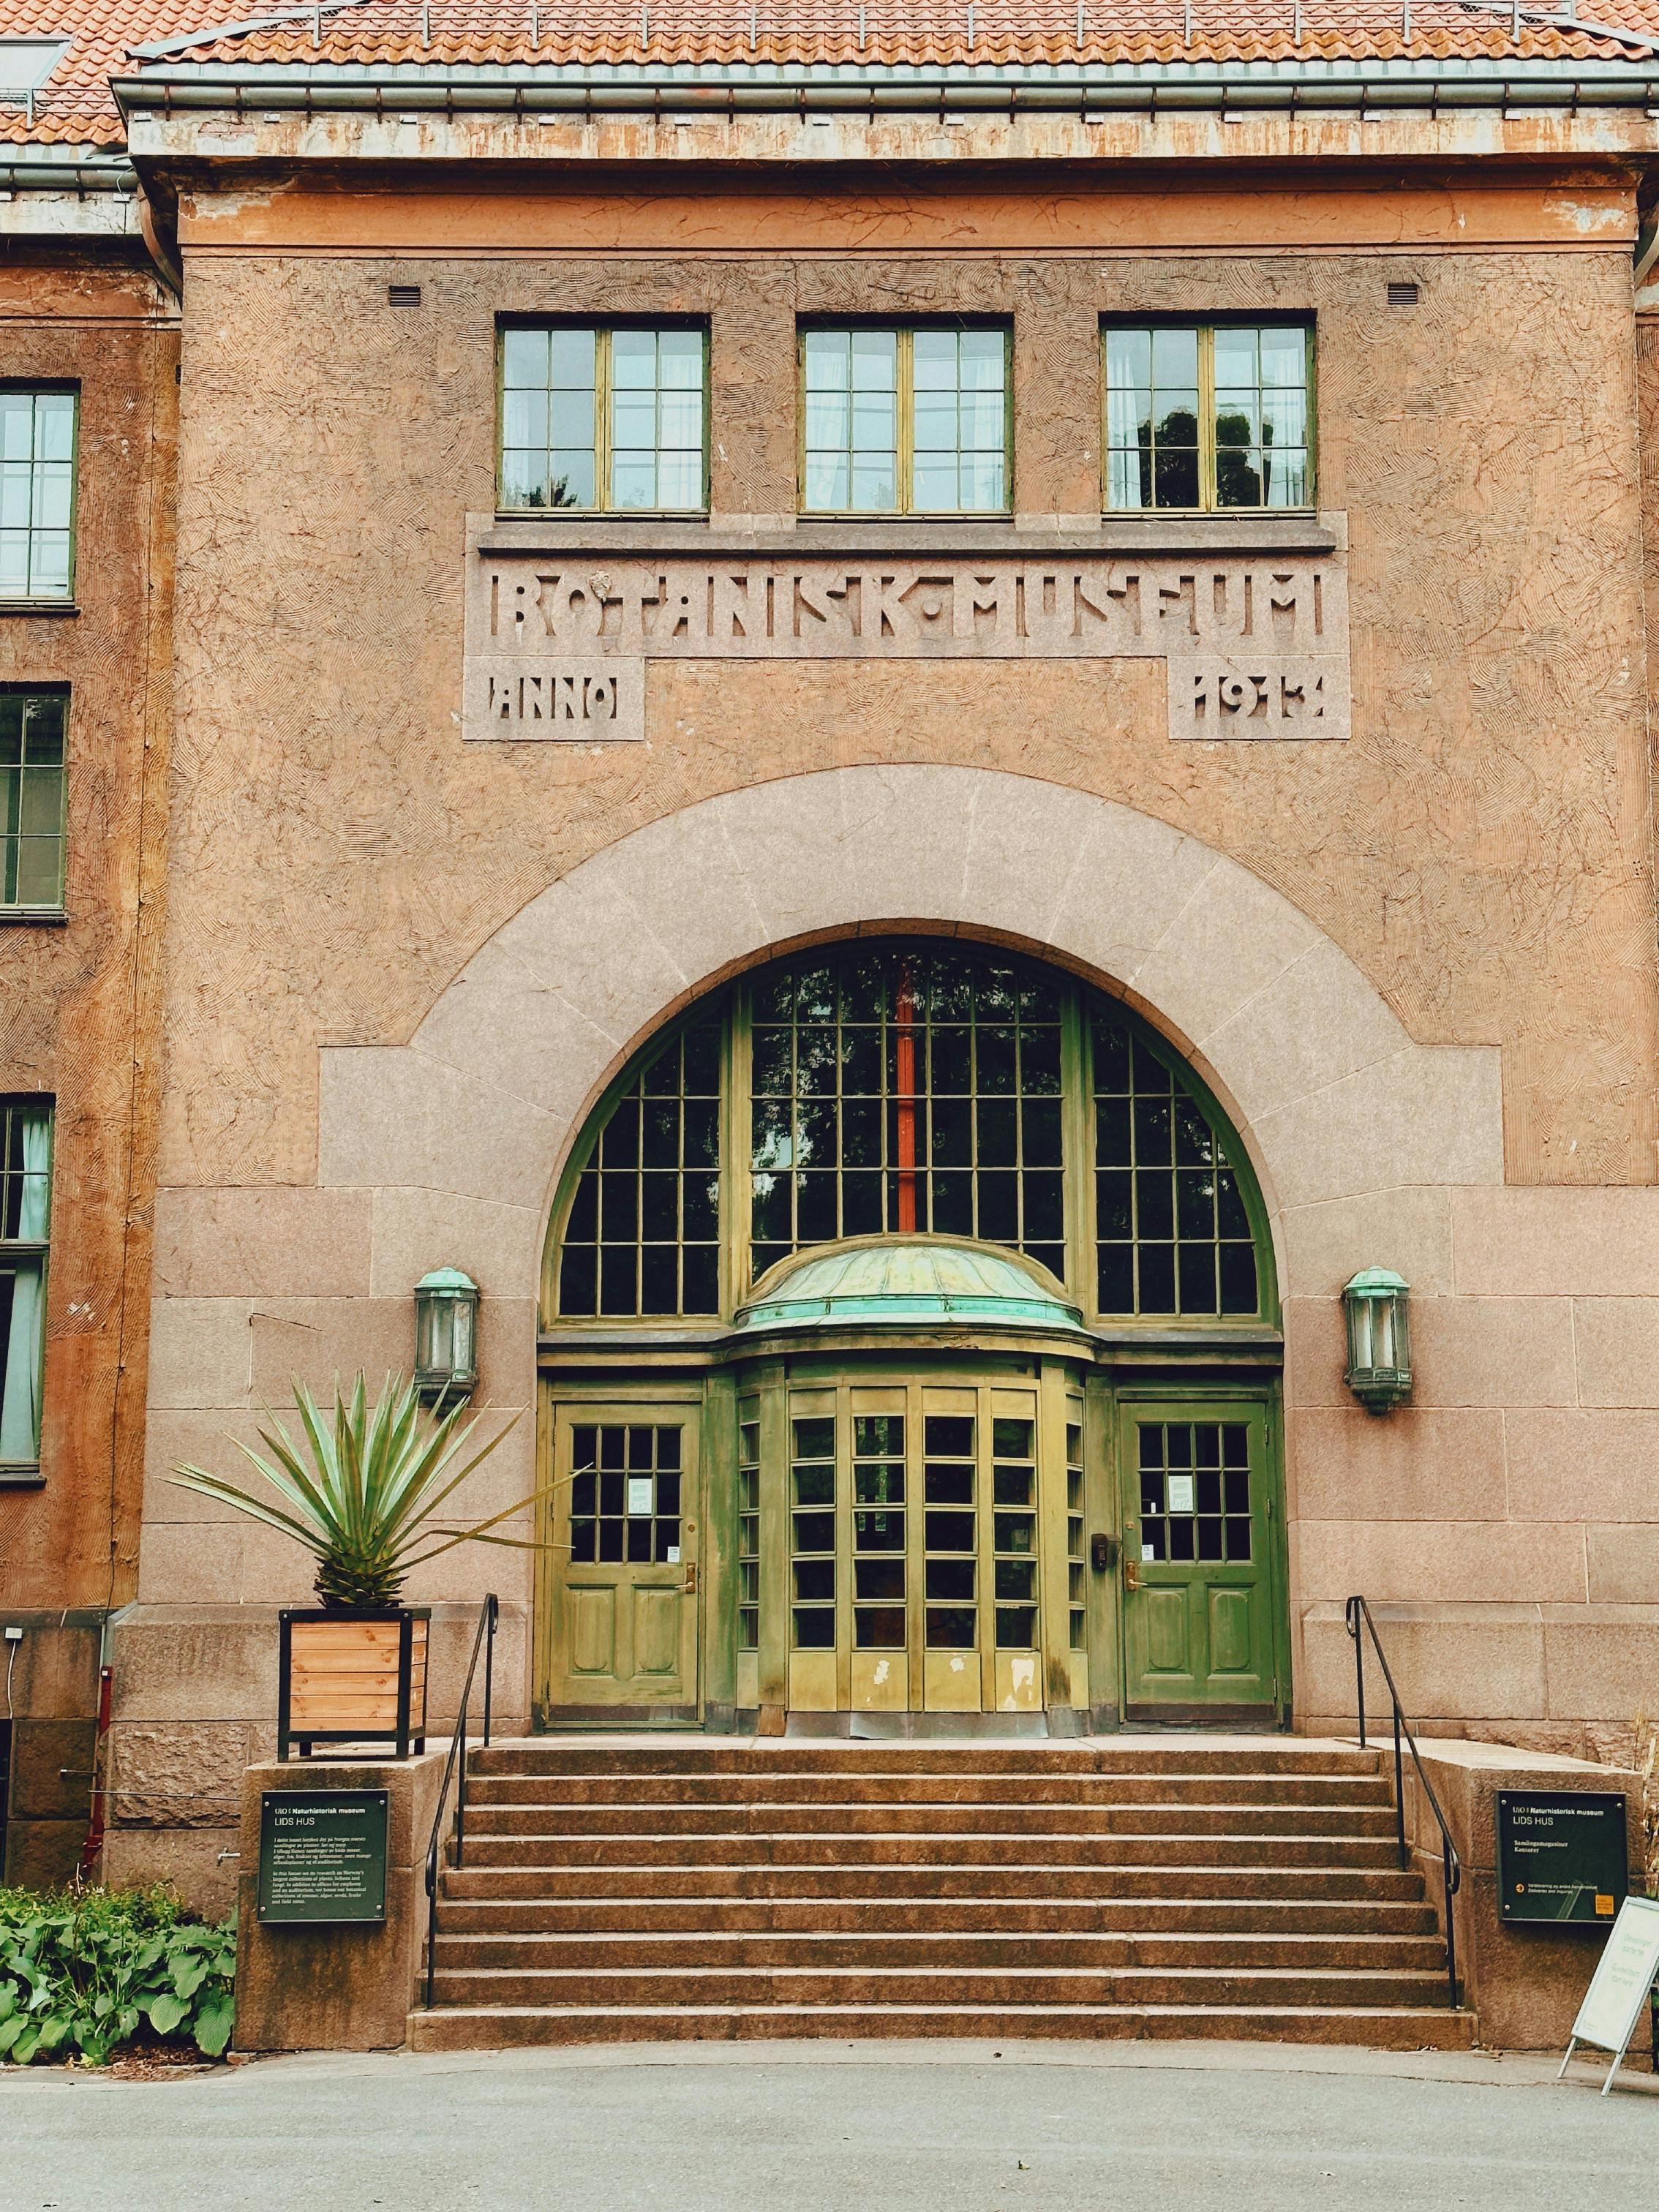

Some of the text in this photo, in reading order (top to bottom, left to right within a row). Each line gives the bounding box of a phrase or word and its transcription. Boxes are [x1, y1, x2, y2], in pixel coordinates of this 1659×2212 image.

[492, 574, 1318, 638] BOTANISK MUSEUM
[490, 677, 617, 719] ANNO
[1195, 675, 1323, 719] 1913
[274, 1817, 315, 1826] LIDS HUS
[1513, 1816, 1554, 1826] LIDS HUS
